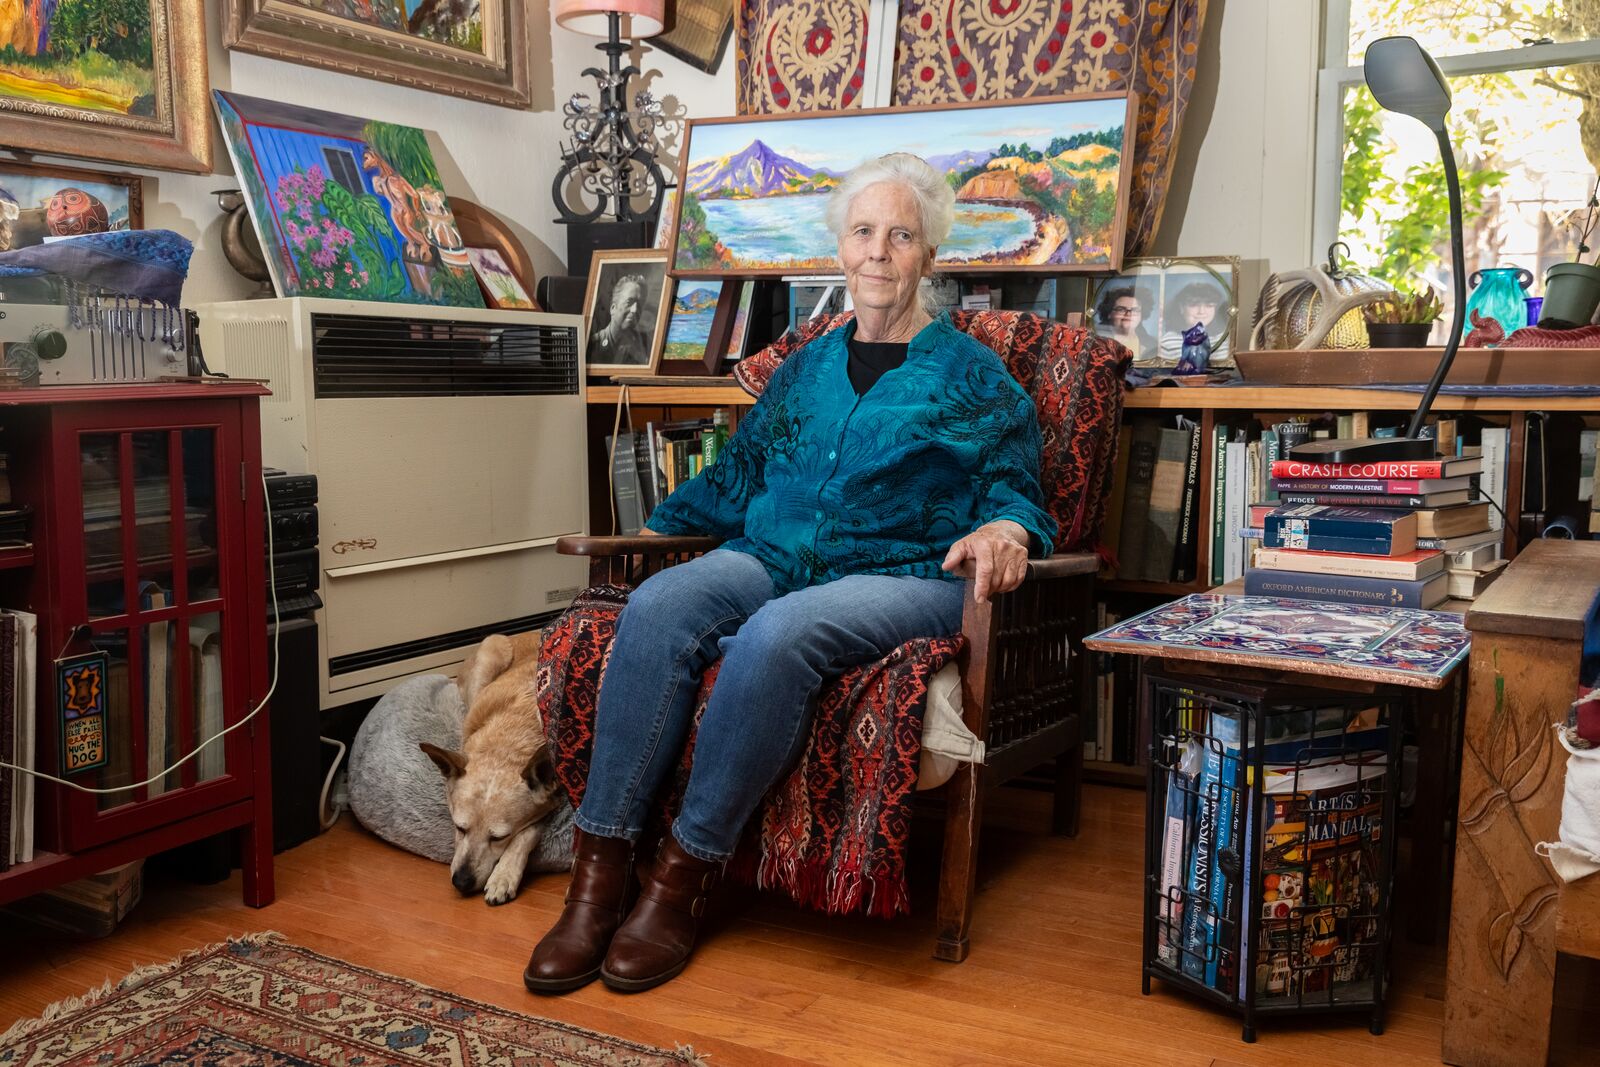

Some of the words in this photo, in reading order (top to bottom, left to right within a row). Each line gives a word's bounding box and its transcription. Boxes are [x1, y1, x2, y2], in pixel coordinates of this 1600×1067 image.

[1190, 426, 1201, 451] MAGIC
[1219, 435, 1227, 448] The
[1187, 450, 1199, 485] SYMBOLS
[1218, 448, 1226, 478] American
[1288, 463, 1342, 478] CRASH
[1348, 463, 1418, 478] COURSE
[1216, 479, 1225, 522] Impressionists
[1317, 496, 1329, 504] the
[1330, 497, 1360, 505] greatest
[1362, 496, 1377, 504] evil
[1262, 583, 1294, 592] OXFORD
[1294, 585, 1335, 597] AMERICAN
[1336, 588, 1387, 600] DICTIONARY
[67, 729, 81, 737] ELSE
[83, 724, 101, 733] FAILS
[68, 720, 87, 729] WHEN
[68, 743, 85, 754] HUG
[87, 739, 101, 749] THE
[73, 750, 97, 766] DOG
[1219, 796, 1229, 828] SOCIETY
[1219, 827, 1226, 839] OF
[1308, 815, 1367, 841] MANUAL
[1169, 822, 1181, 860] California
